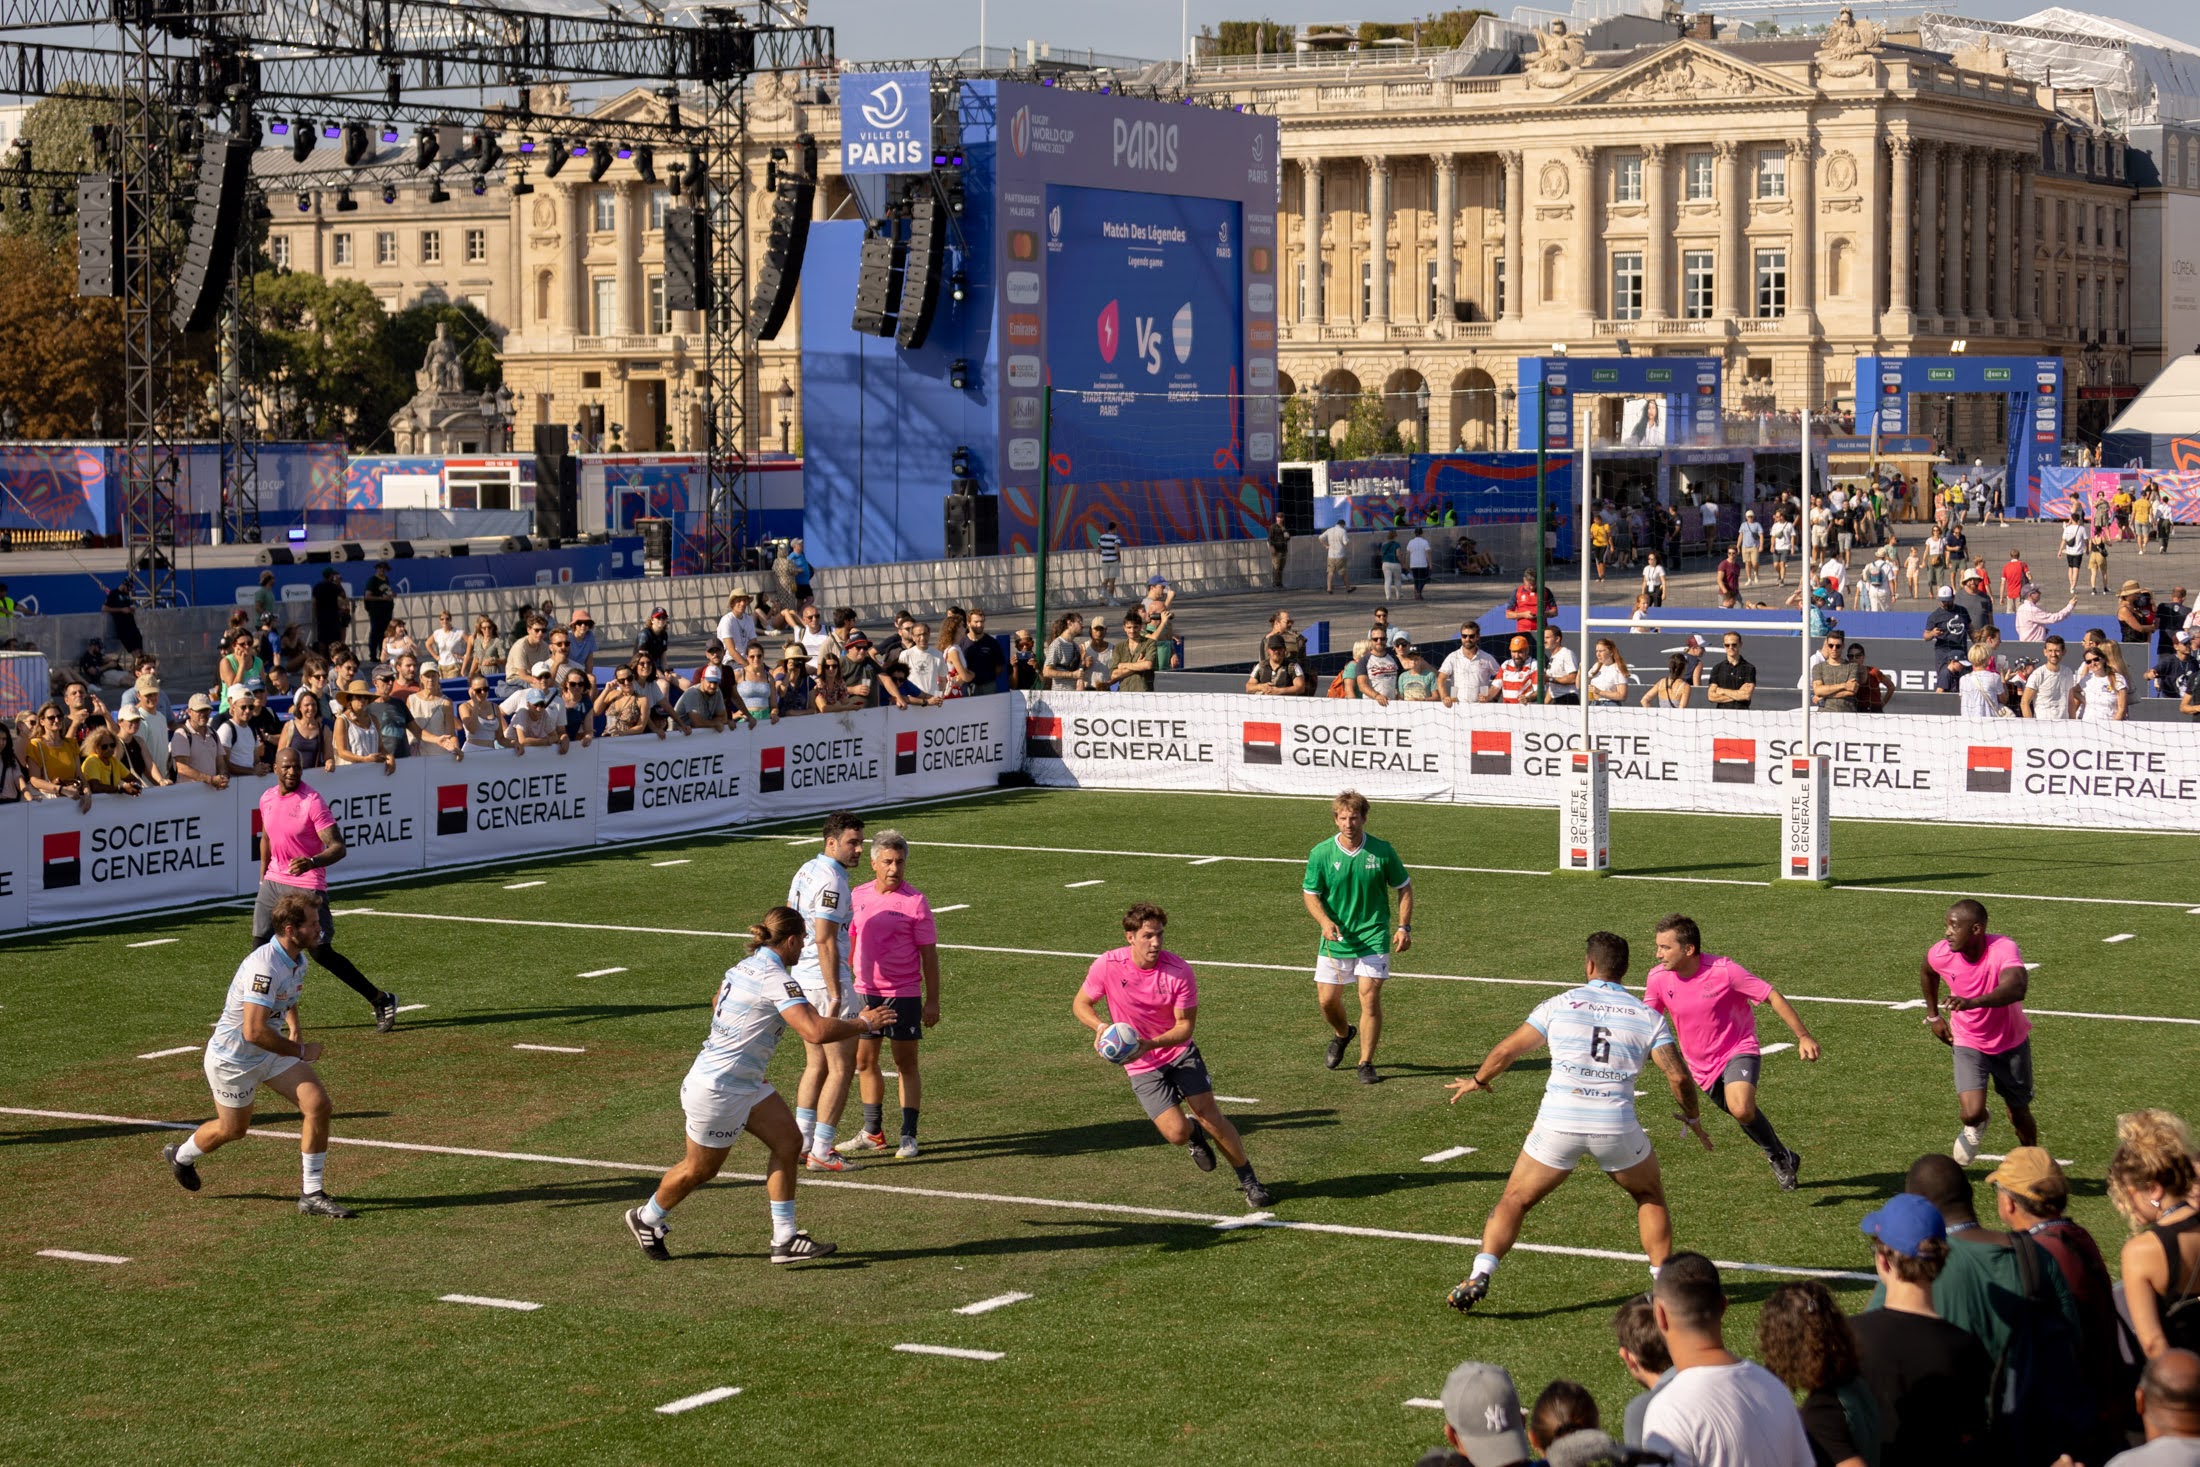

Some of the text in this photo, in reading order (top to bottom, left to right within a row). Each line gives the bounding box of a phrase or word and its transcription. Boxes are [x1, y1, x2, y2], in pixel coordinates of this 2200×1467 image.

[1032, 114, 1049, 125] RUGBY
[860, 130, 910, 140] VILLE DE
[1032, 127, 1074, 144] WORLD CUP
[1032, 142, 1065, 154] FRANCE 2023
[1113, 117, 1178, 173] PARIS
[848, 141, 922, 165] PARIS
[1248, 169, 1268, 184] PARIS
[1004, 192, 1040, 205] PARTENAIRES
[1009, 206, 1036, 218] MAJEURS
[1103, 221, 1186, 245] Match Des Légendes
[1128, 255, 1163, 270] Legends game
[1216, 247, 1231, 258] PARIS
[1009, 322, 1038, 336] Emirates
[1099, 405, 1119, 417] PARIS
[924, 721, 989, 749] SOCIETE
[1073, 717, 1187, 739] SOCIETE
[1293, 723, 1412, 748] SOCIETE
[791, 737, 864, 765] SOCIETE
[922, 743, 1003, 772] GENERALE
[1073, 740, 1214, 763] GENERALE
[1293, 747, 1439, 773] GENERALE
[2025, 747, 2166, 773] SOCIETE
[643, 753, 724, 783] SOCIETE
[791, 759, 878, 789] GENERALE
[1524, 756, 1678, 782] GERALE
[1768, 764, 1931, 790] GERALE
[476, 773, 567, 803] SOCIETE
[642, 776, 740, 809] GENERALE
[2025, 773, 2197, 800] GENERALE
[329, 793, 392, 822] CIETE
[476, 797, 586, 831] GENERALE
[1571, 790, 1579, 844] SOCIETE
[1579, 777, 1588, 844] GENERALE
[1801, 783, 1810, 852] GENERALE
[91, 816, 201, 852] SOCIETE
[343, 817, 413, 848] ERALE
[1792, 796, 1800, 852] SOCIETE
[91, 842, 225, 883] GENERALE
[255, 975, 270, 983] TOP
[1588, 1003, 1636, 1016] NATIXIS
[1590, 1025, 1612, 1064] 6
[1580, 1066, 1629, 1082] randstad
